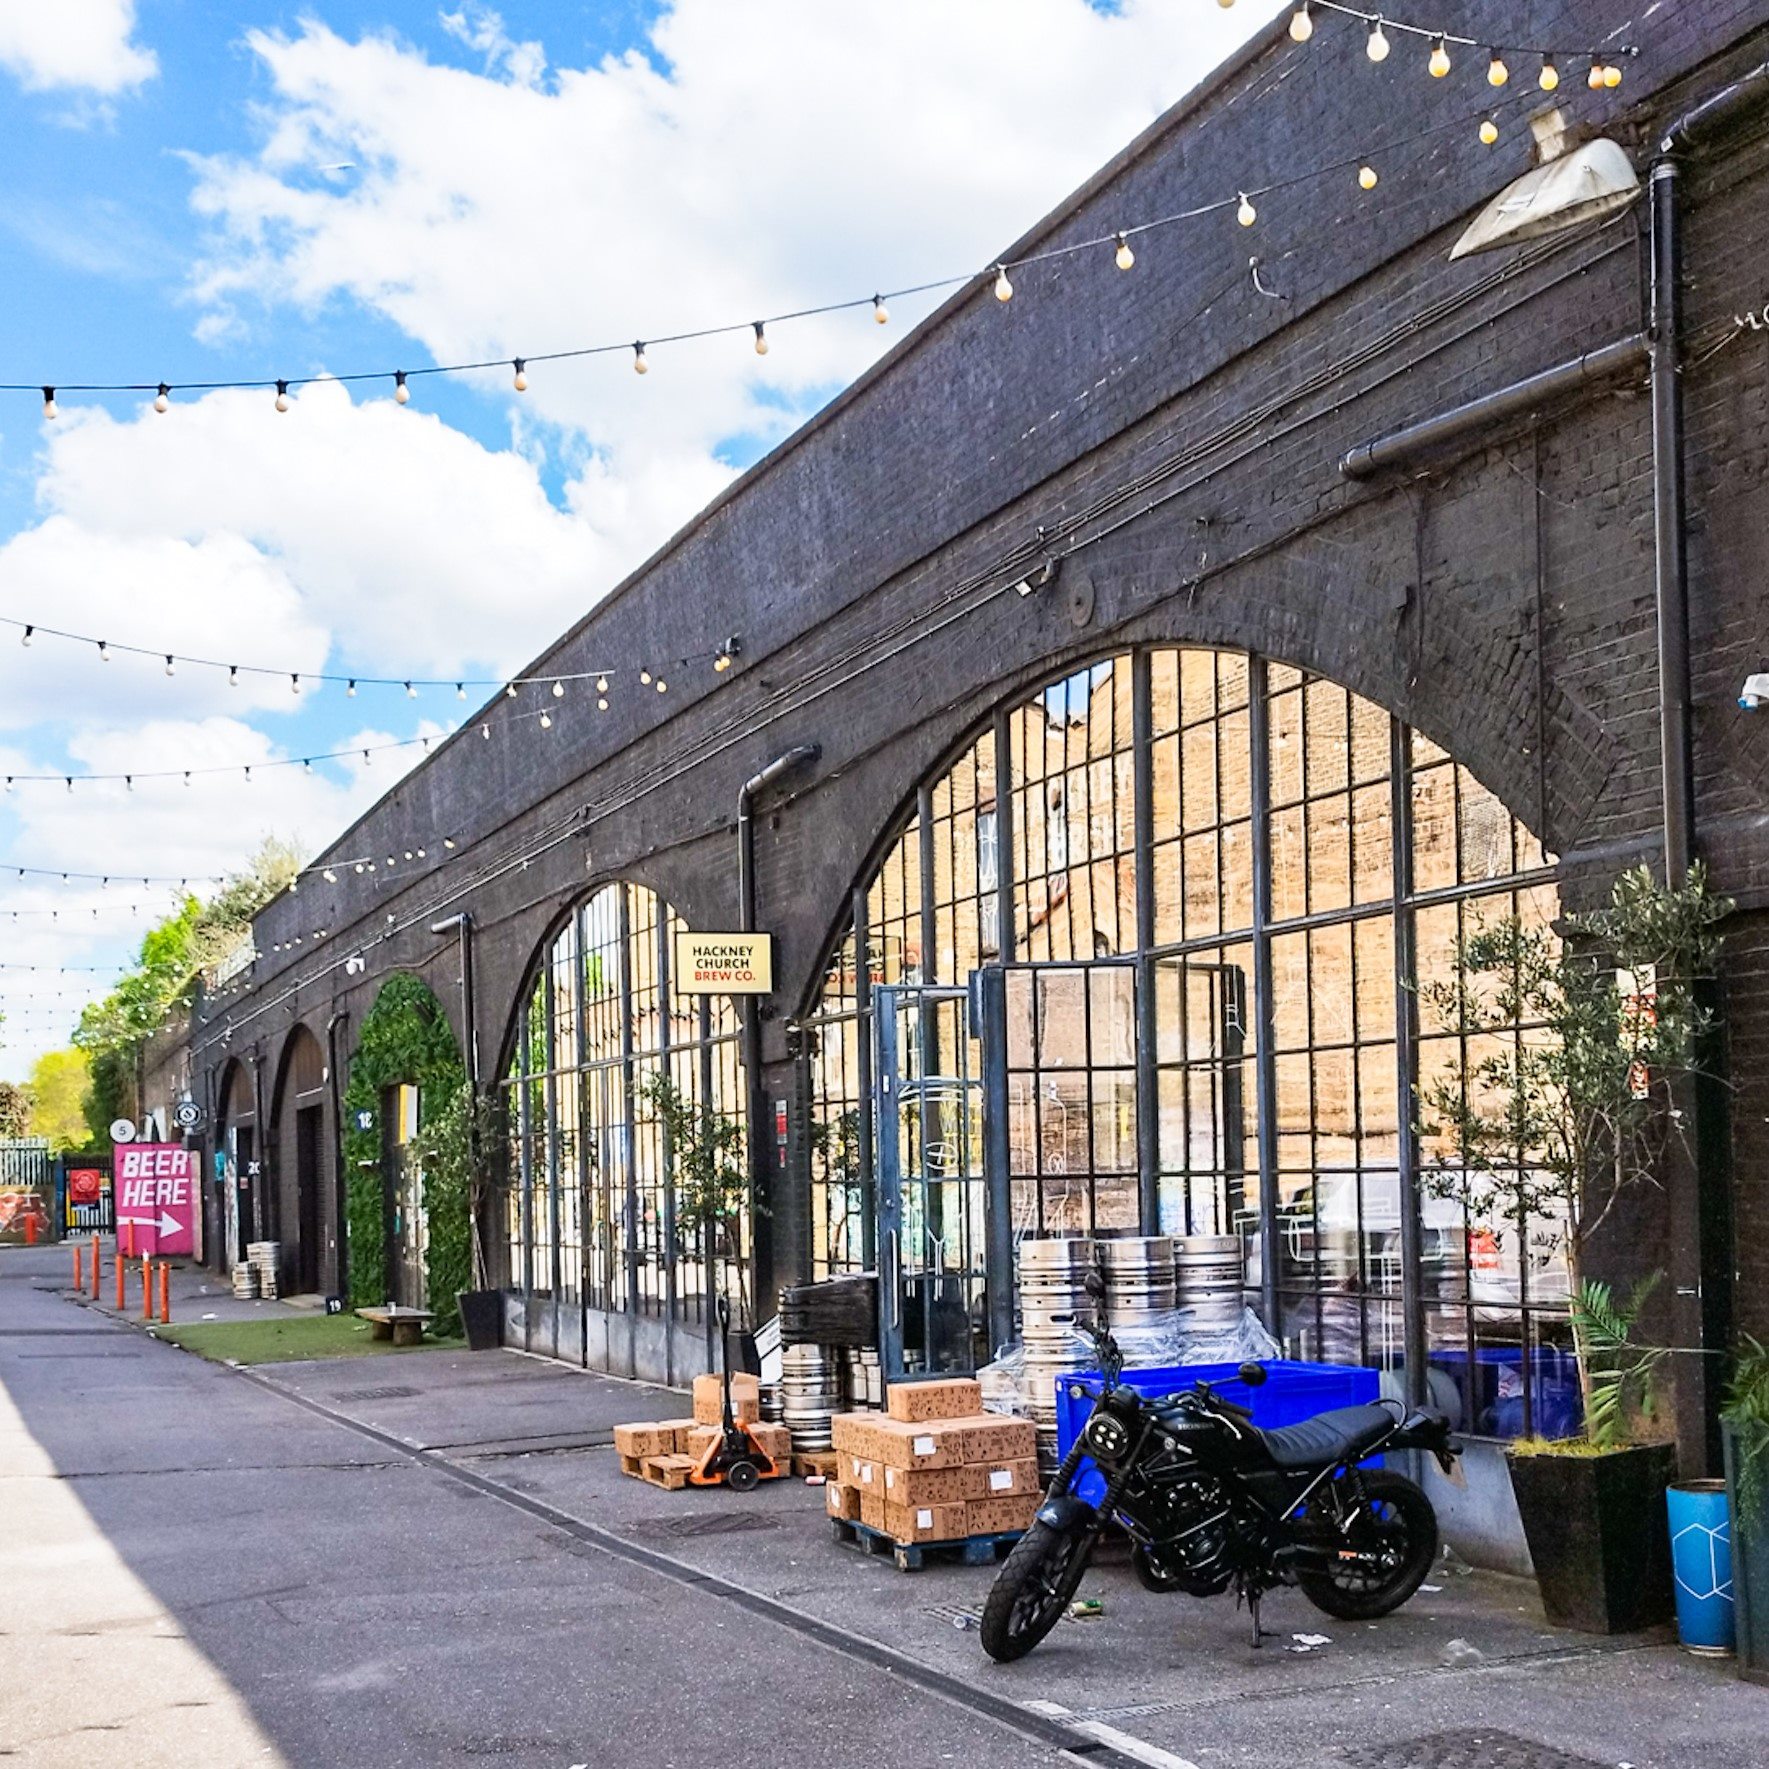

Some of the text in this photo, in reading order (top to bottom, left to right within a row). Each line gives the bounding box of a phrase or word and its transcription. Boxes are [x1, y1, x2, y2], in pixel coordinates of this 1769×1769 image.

[692, 946, 754, 956] HACKNEY
[696, 959, 750, 969] CHURCH
[694, 971, 756, 981] BREW CO.
[118, 1126, 127, 1136] 5
[122, 1150, 189, 1178] BEER
[122, 1178, 189, 1207] HERE
